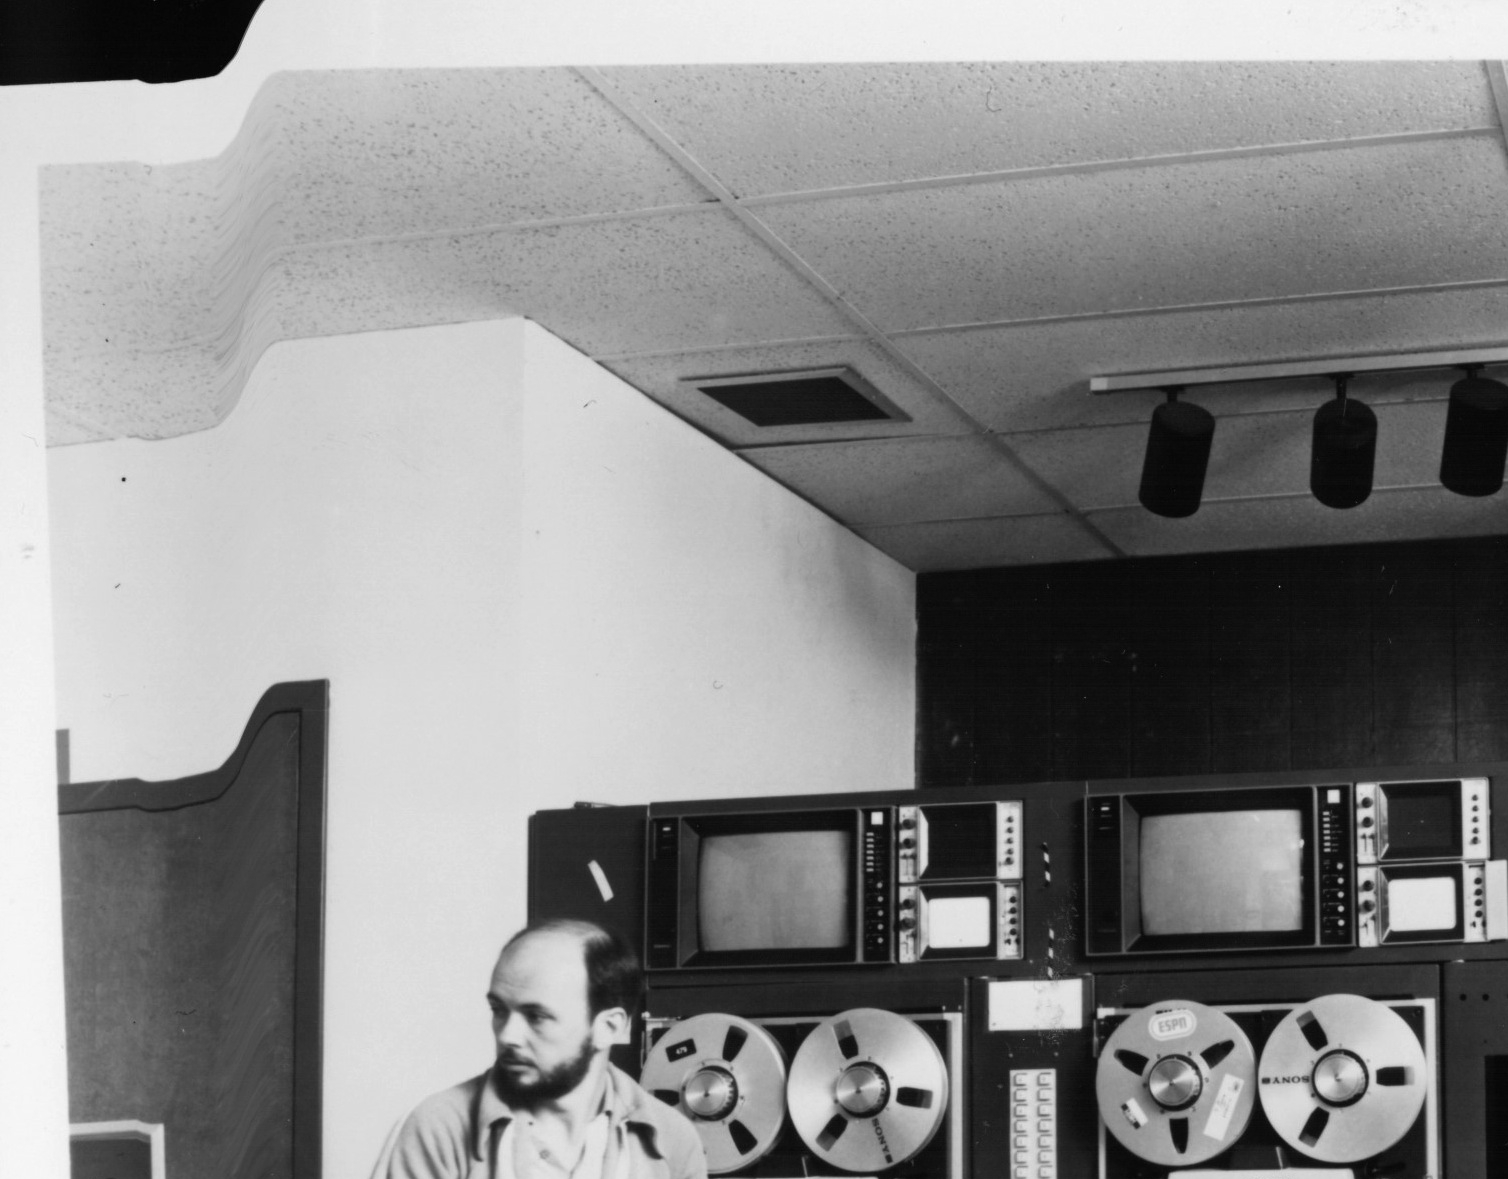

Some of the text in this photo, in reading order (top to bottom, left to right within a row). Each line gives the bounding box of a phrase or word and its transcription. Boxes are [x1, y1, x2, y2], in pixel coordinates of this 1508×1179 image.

[1158, 1016, 1187, 1033] ESPN
[1271, 1075, 1311, 1085] SONY
[872, 1117, 890, 1153] SONY
